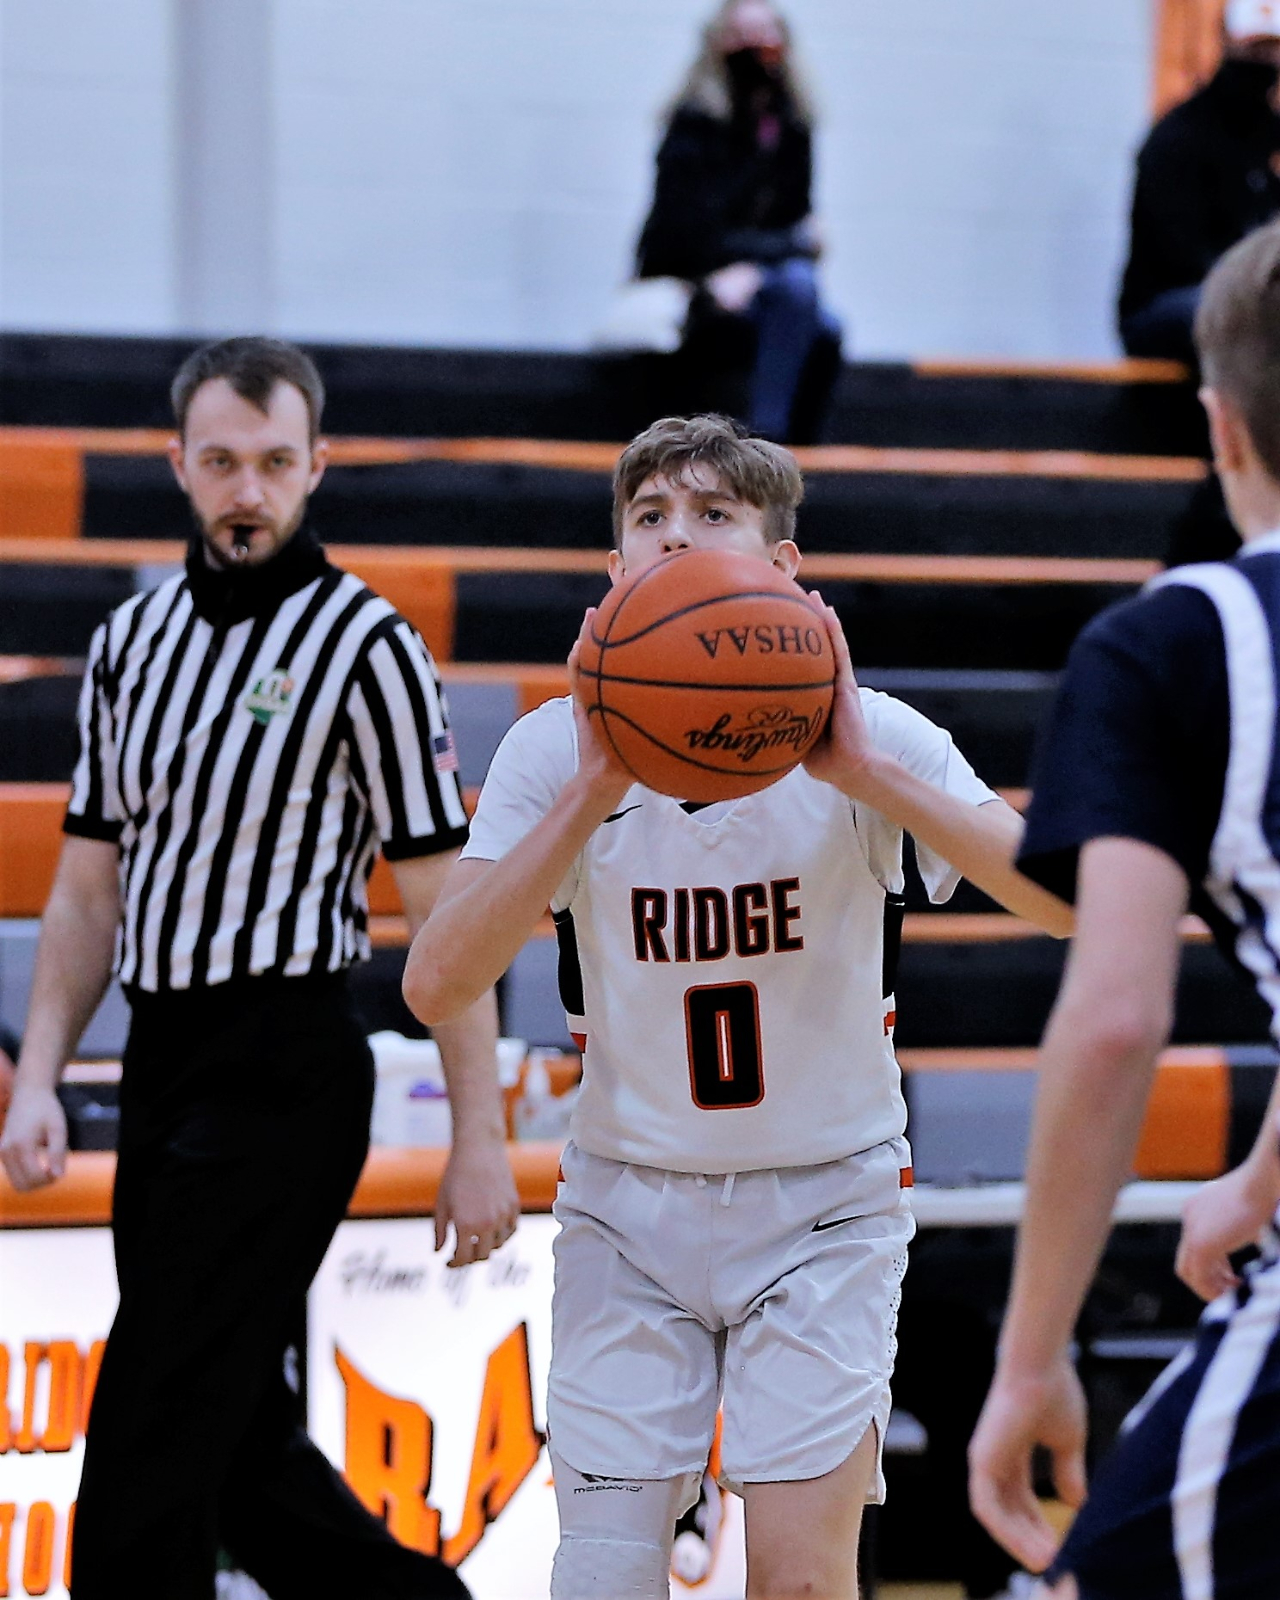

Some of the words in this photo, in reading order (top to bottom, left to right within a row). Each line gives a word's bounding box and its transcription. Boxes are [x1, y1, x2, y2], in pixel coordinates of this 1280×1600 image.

[695, 624, 823, 659] OHSAA
[685, 706, 823, 762] Rawlings
[631, 877, 804, 962] RIDGE
[684, 980, 765, 1110] 0
